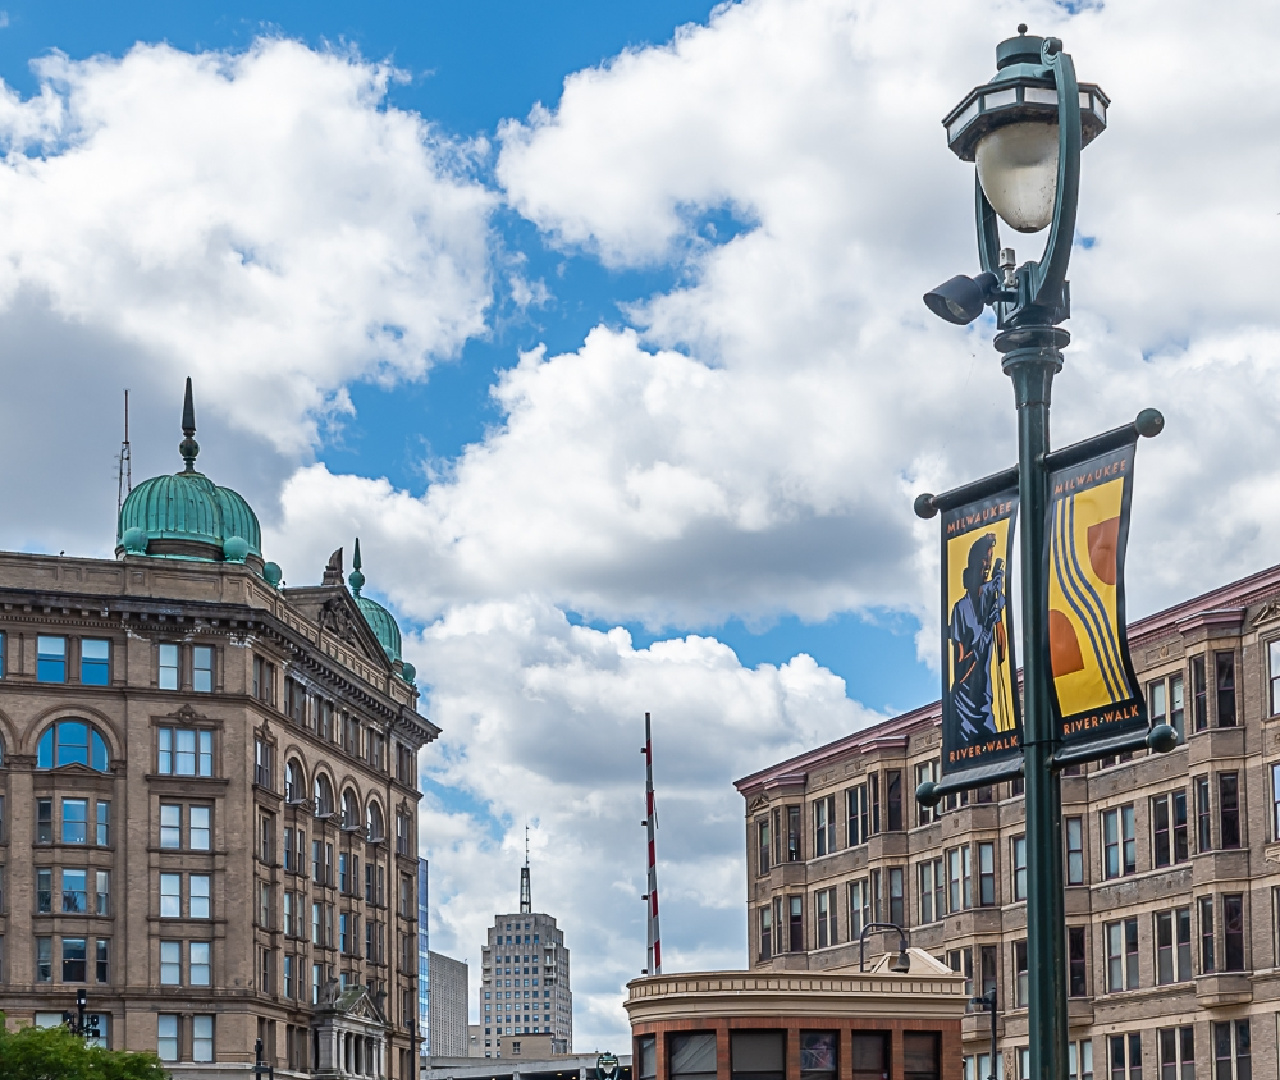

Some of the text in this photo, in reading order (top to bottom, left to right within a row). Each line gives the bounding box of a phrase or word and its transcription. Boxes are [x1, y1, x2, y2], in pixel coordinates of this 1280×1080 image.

[1054, 459, 1126, 495] MILWAUKEE
[947, 501, 1012, 534] MILWAUKEE
[1063, 704, 1139, 735] RIVER WALK
[949, 735, 1019, 763] RIVER WALK
